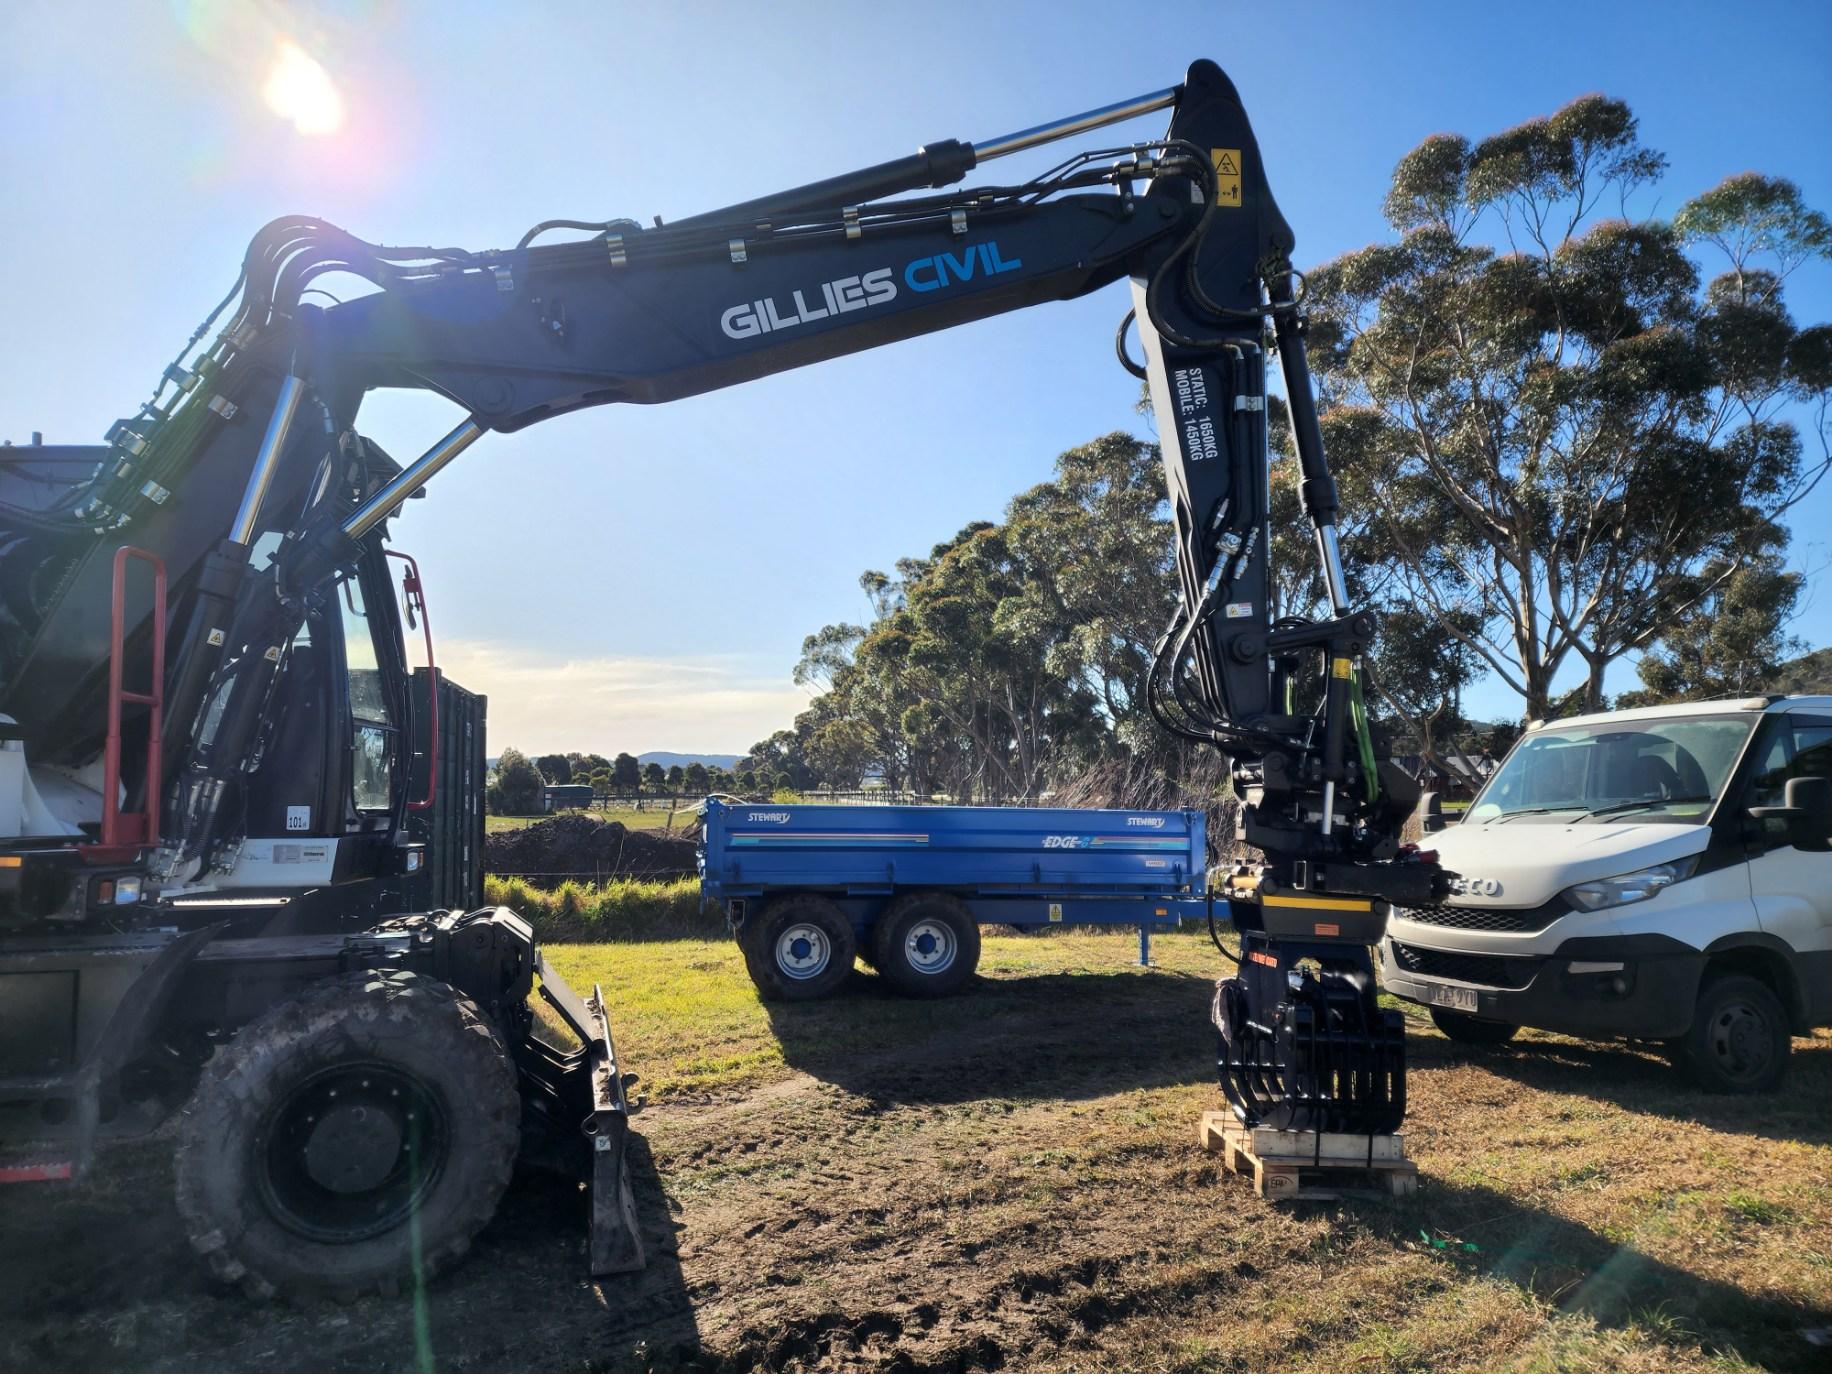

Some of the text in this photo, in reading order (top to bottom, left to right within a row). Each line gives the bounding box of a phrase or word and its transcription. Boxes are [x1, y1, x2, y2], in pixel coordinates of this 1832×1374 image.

[720, 240, 1023, 340] GILLIES CIVIL
[1175, 369, 1204, 461] MOBILE: 1450KG
[1189, 367, 1218, 459] STATIC: 1650KG
[289, 816, 302, 828] 101
[748, 812, 791, 824] STEWART
[1127, 817, 1165, 828] STEWART
